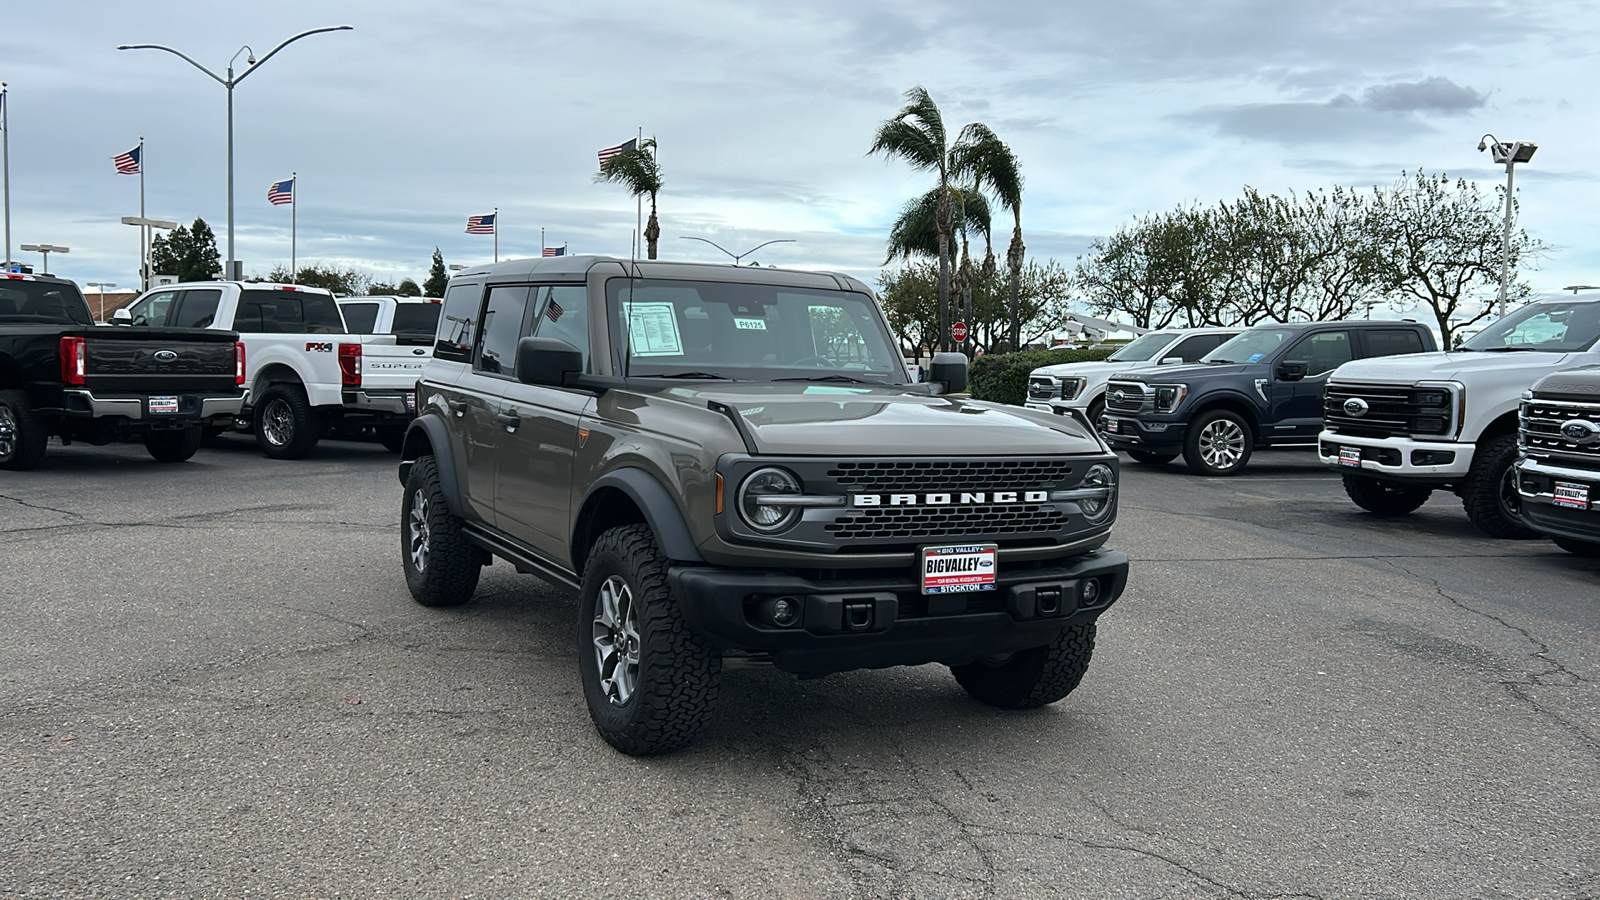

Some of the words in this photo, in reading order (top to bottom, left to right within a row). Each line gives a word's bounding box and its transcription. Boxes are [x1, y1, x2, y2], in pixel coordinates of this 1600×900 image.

[953, 328, 967, 336] STOP
[305, 342, 333, 353] FX4
[1545, 382, 1597, 392] SUPER
[1556, 488, 1580, 498] BIGVALLEY
[853, 491, 1048, 506] BRONCO
[940, 584, 980, 593] STOCKTON
